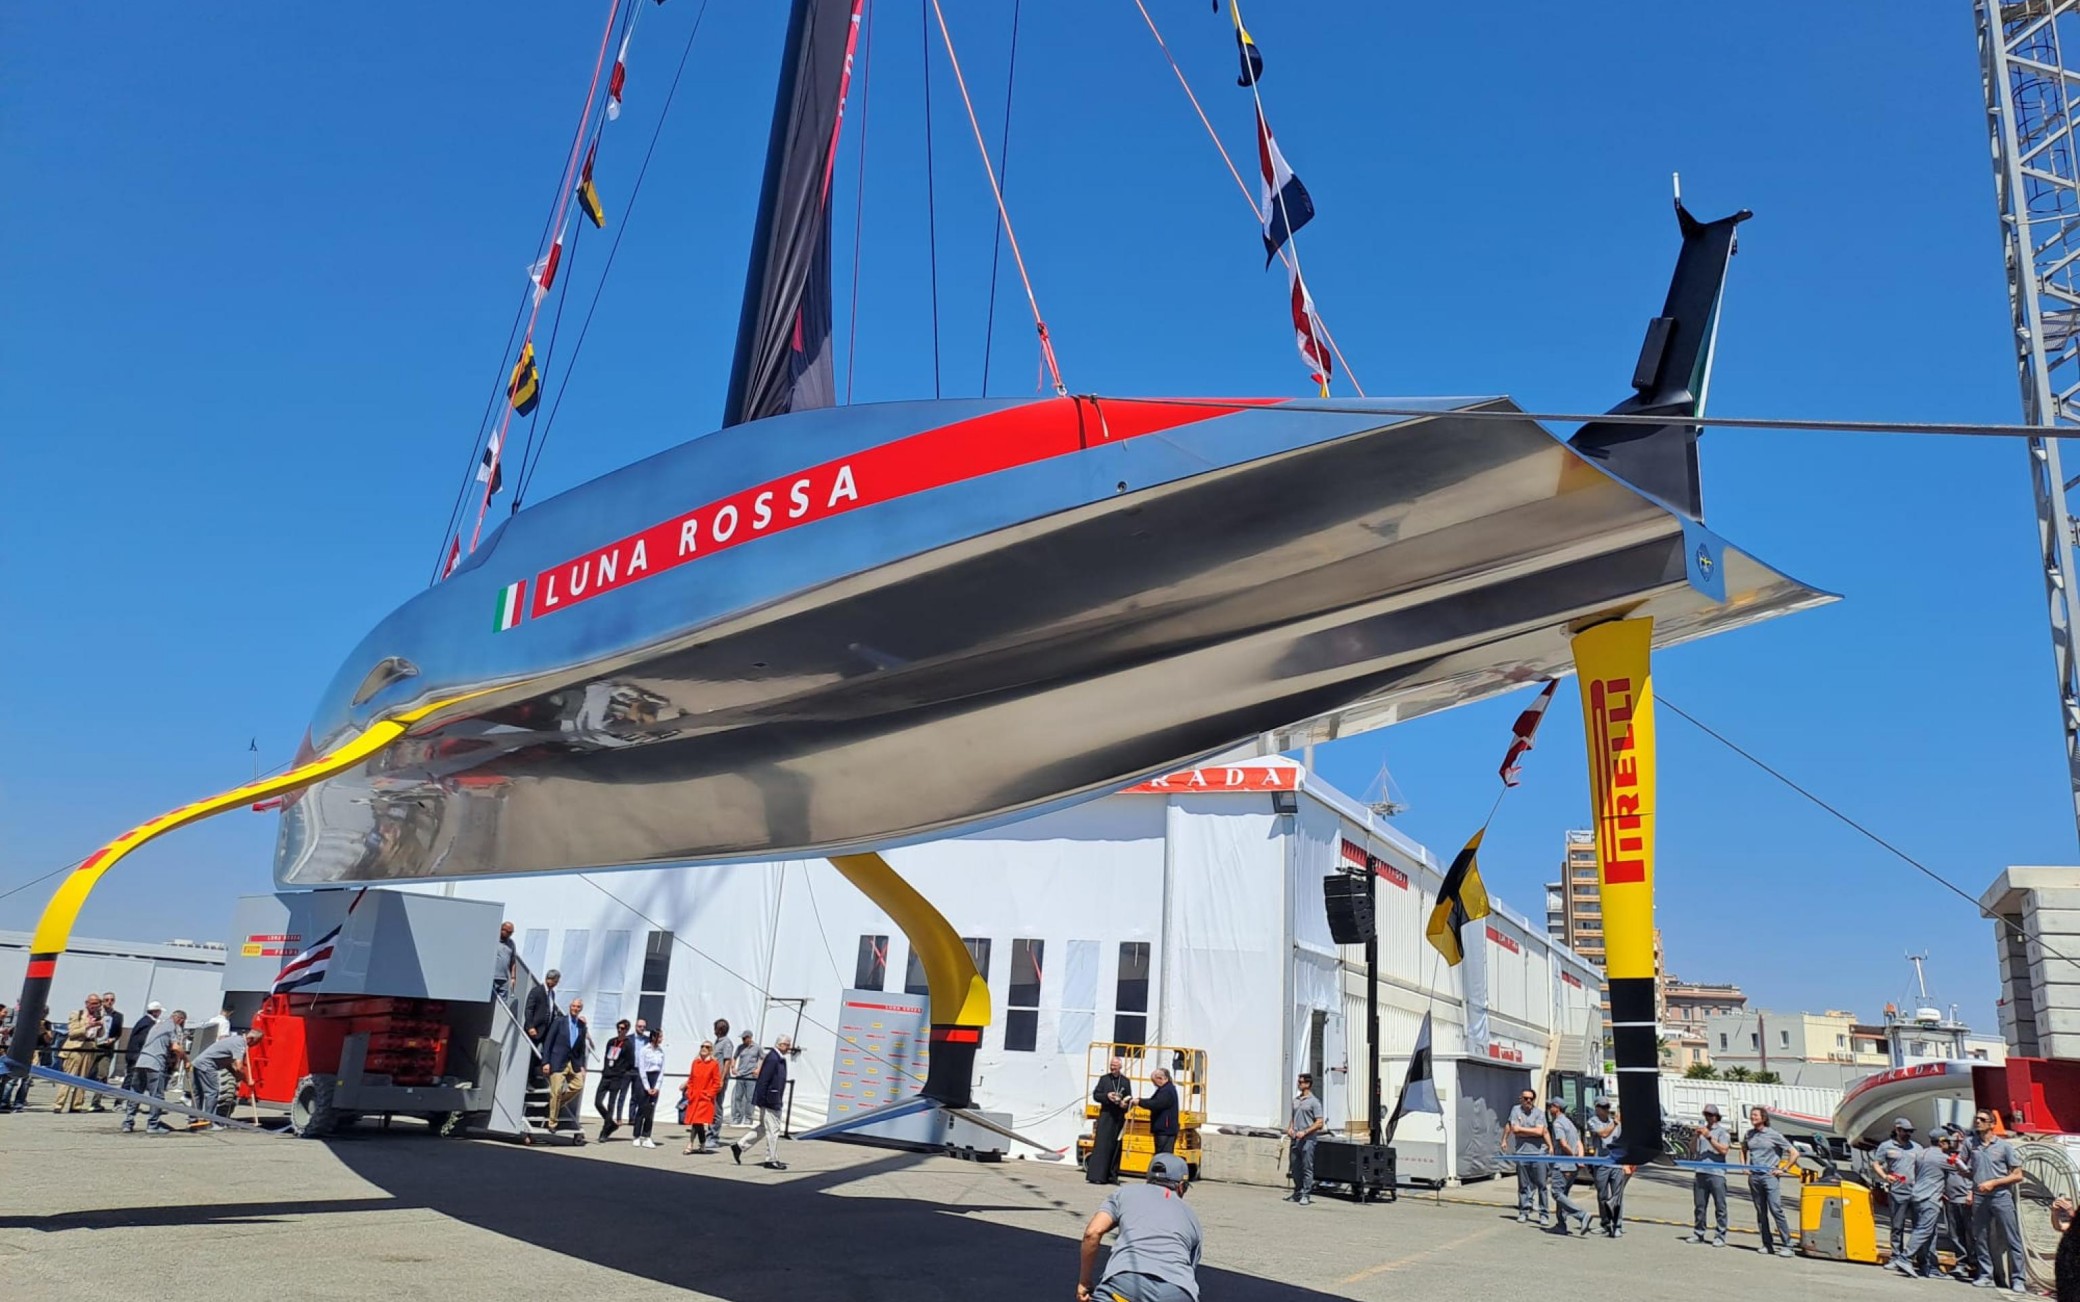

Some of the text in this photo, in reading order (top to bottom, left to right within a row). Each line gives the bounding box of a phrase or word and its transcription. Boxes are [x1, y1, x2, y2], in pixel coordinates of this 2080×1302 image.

[545, 465, 859, 607] LUNA ROSSA
[1151, 768, 1282, 787] RADA
[1590, 678, 1645, 884] PIRELLI
[1877, 1063, 1939, 1082] PRADA
